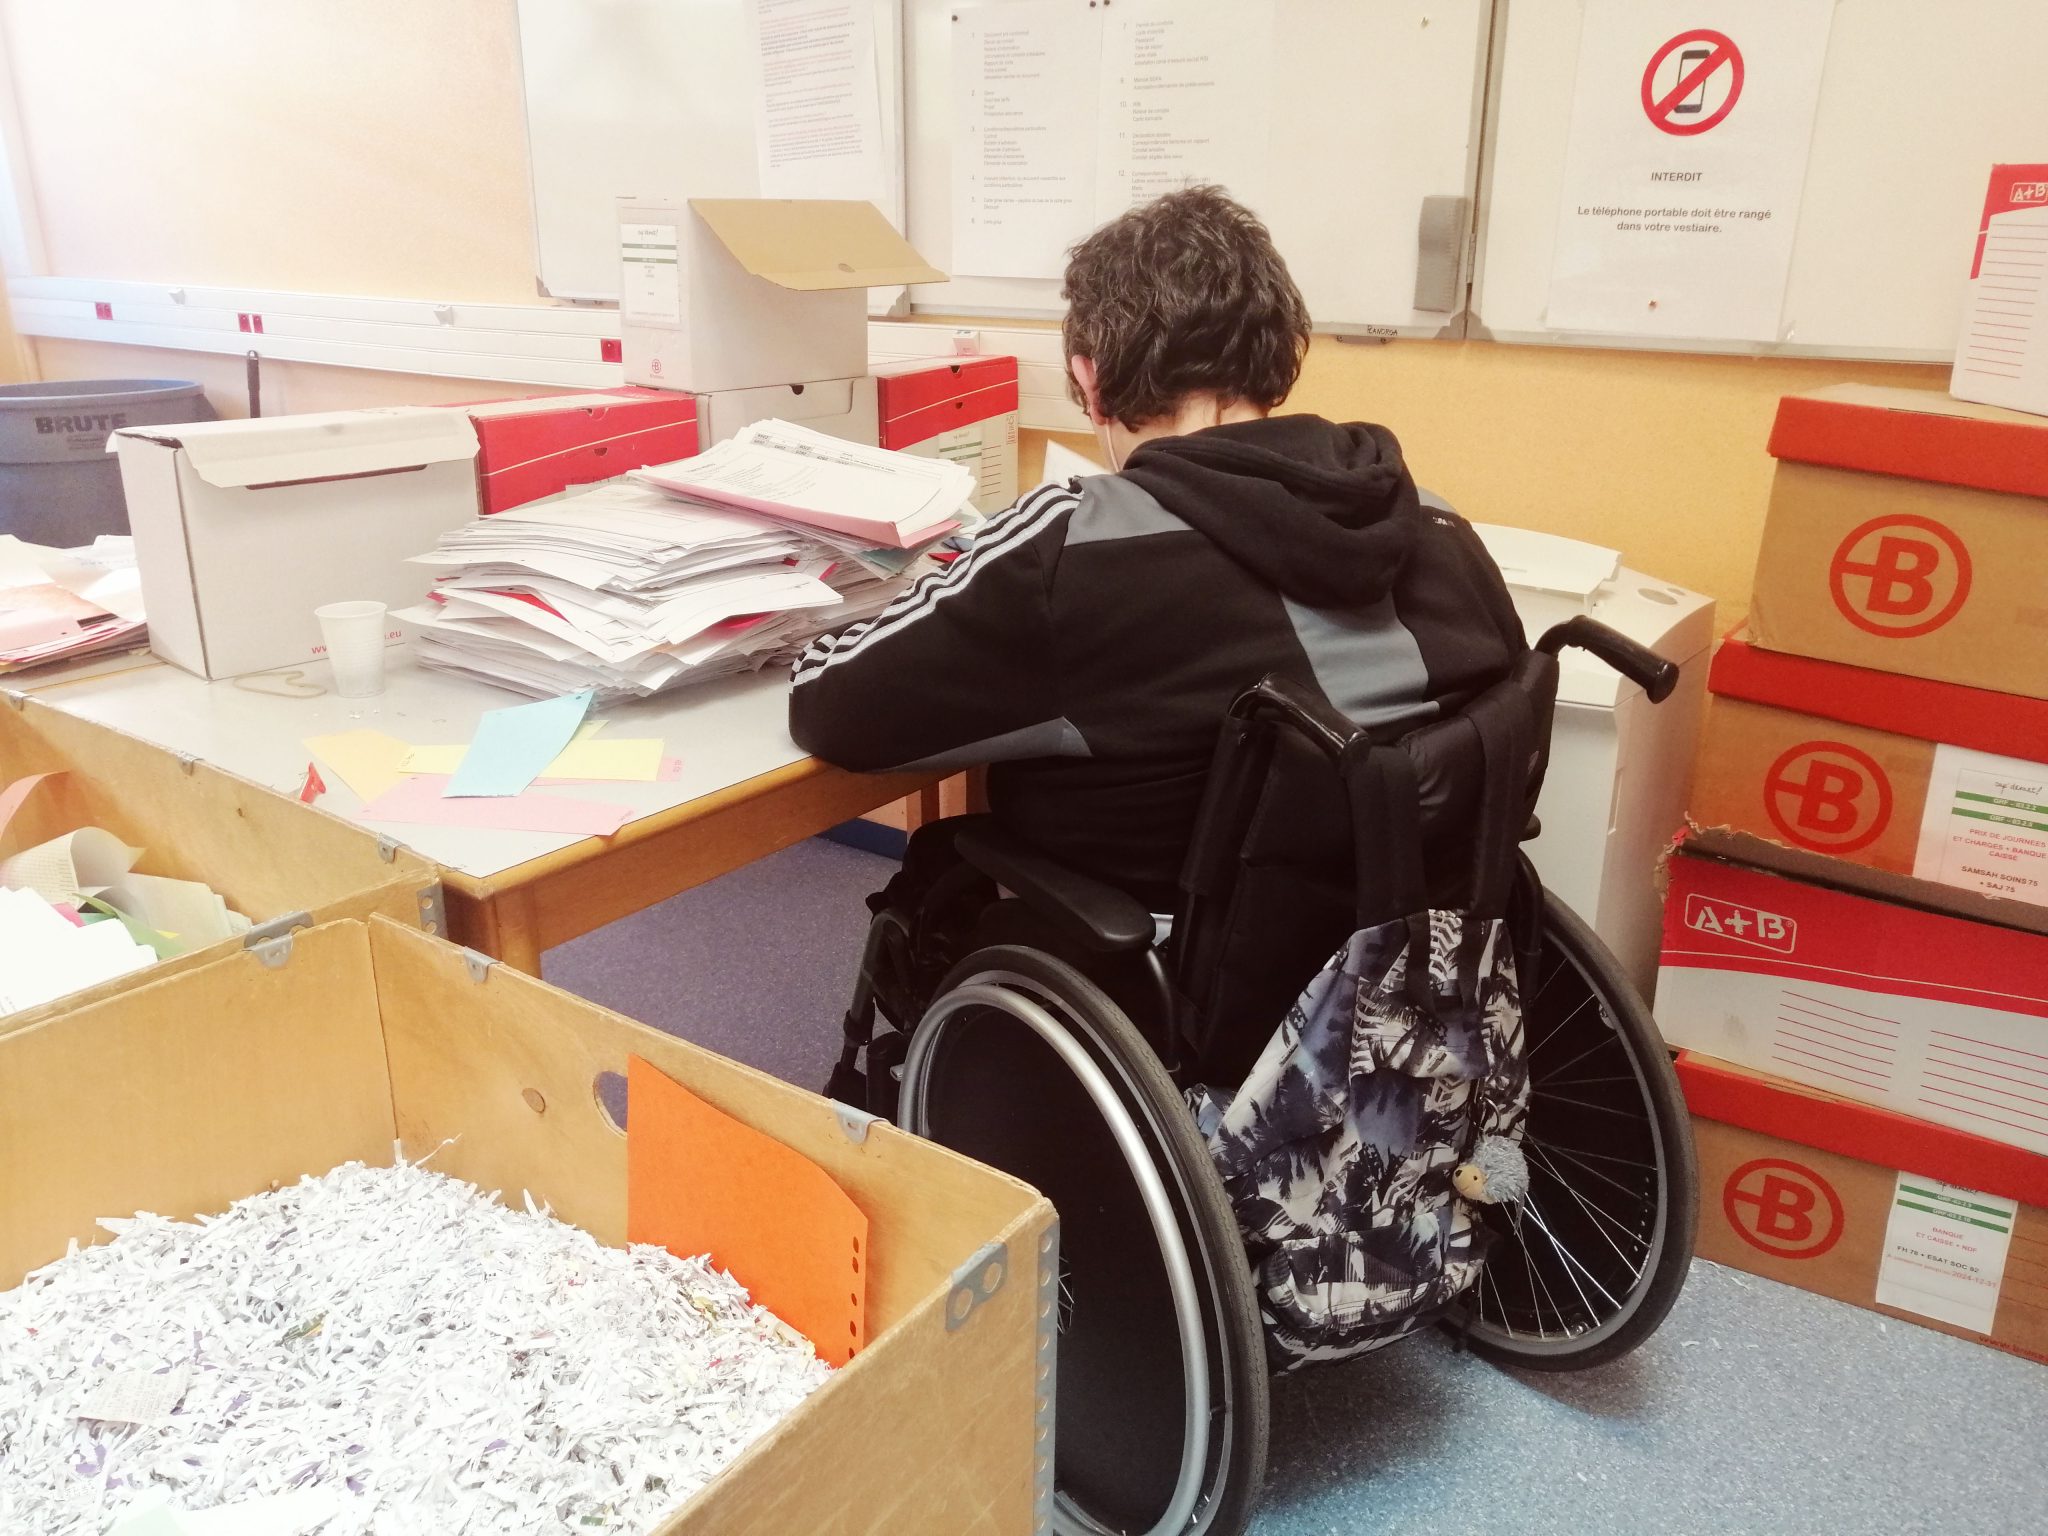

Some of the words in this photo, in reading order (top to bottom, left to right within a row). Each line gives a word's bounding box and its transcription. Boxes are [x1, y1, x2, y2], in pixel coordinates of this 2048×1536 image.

[1650, 172, 1702, 182] INTERDIT
[1578, 206, 1590, 215] Le
[1592, 205, 1642, 217] téléphone
[1644, 207, 1688, 218] portable
[1690, 207, 1712, 218] doit
[1714, 207, 1736, 219] être
[1739, 209, 1772, 221] rangé
[1617, 221, 1641, 231] dans
[1644, 223, 1671, 232] votre
[1673, 223, 1722, 233] vestiaire.
[34, 412, 129, 434] BRUTE
[1969, 829, 1988, 838] PRIX
[1990, 832, 2001, 840] DE
[2002, 834, 2046, 848] JOURNEES
[1964, 838, 2003, 851] CHARGES
[2012, 847, 2046, 859] BANQUE
[1989, 850, 2018, 861] CAISSE
[1961, 865, 1998, 879] SAMSAH
[2000, 871, 2027, 885] SOINS
[2027, 878, 2038, 887] 75
[1986, 881, 2003, 891] SAJ
[2005, 885, 2016, 893] 75
[1695, 905, 1785, 940] A+B
[1927, 1234, 1953, 1246] CAISSE
[1932, 1227, 1964, 1240] BANQUE
[1927, 1253, 1948, 1265] ESAT
[1950, 1260, 1968, 1270] SOC
